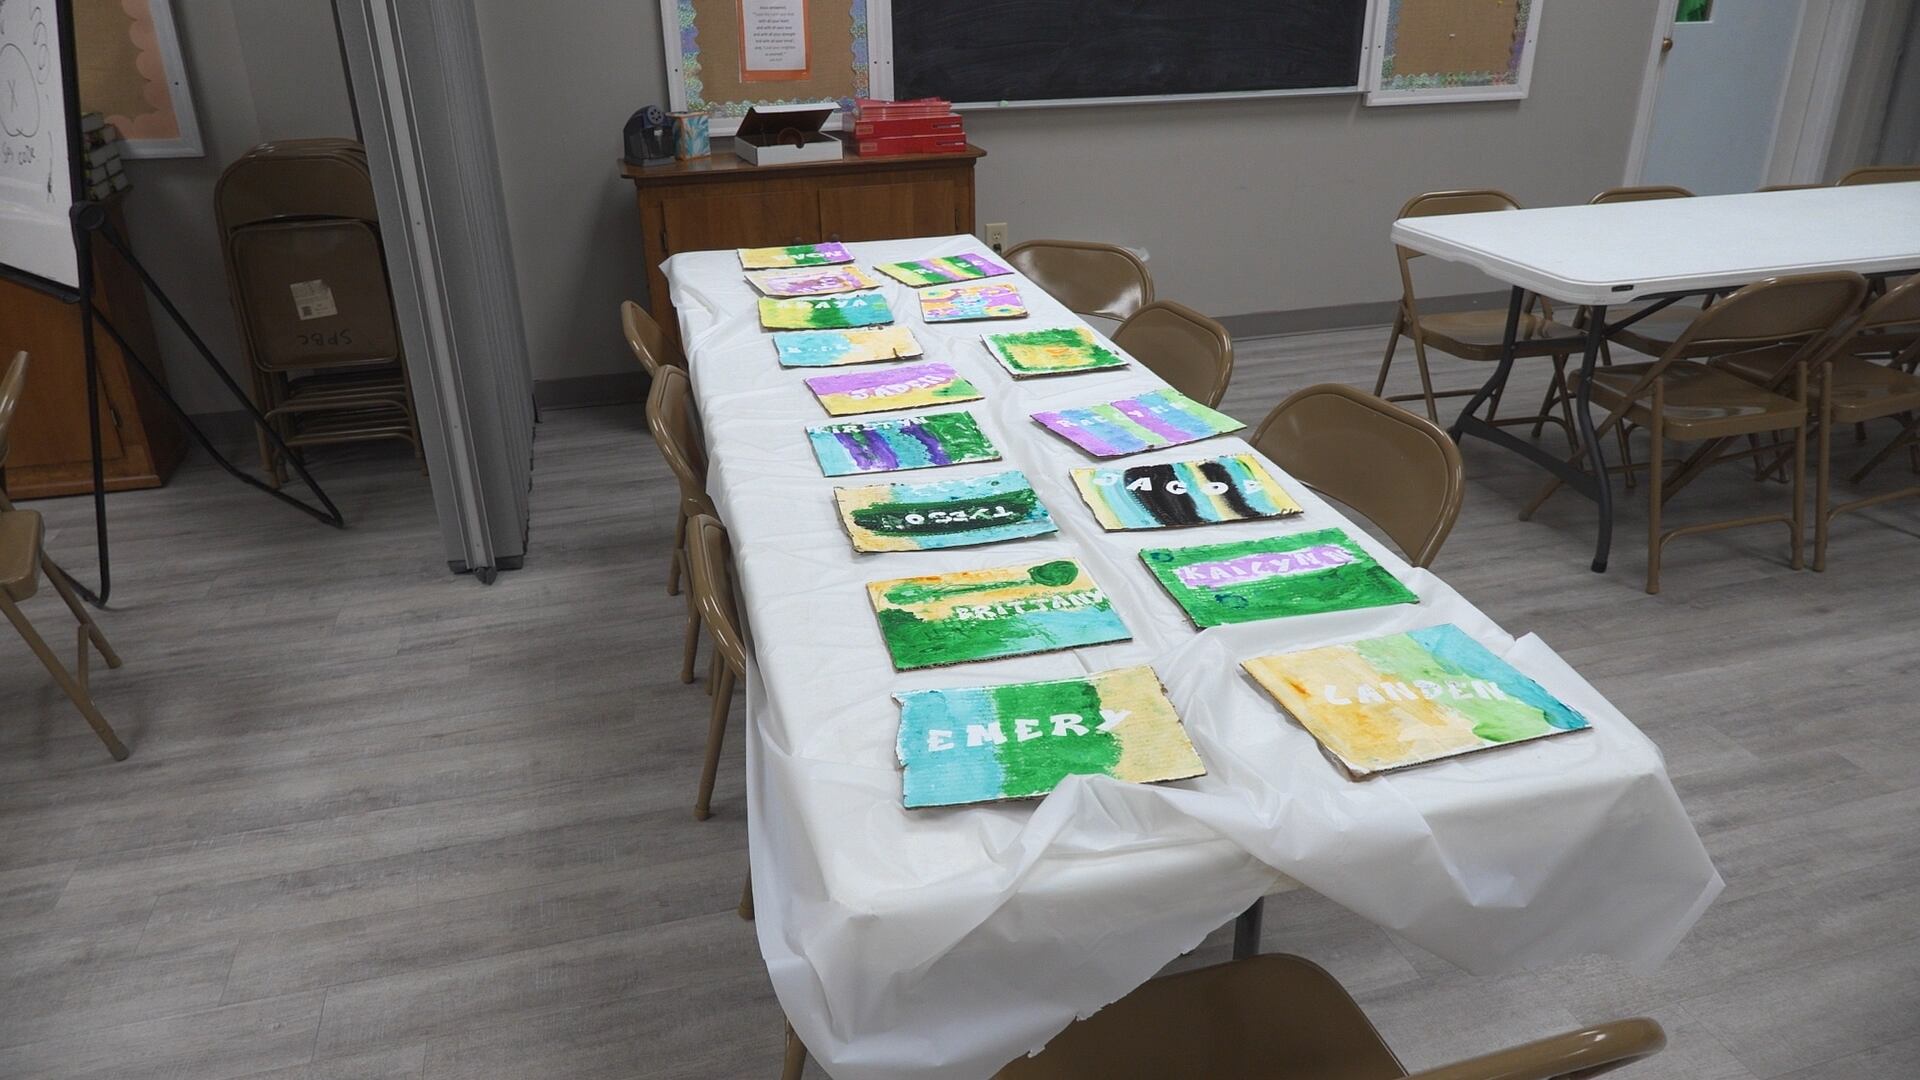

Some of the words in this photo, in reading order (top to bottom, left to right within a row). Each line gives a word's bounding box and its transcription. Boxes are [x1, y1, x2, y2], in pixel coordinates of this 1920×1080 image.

[297, 328, 353, 346] SPBC
[850, 375, 949, 400] JADEN
[955, 588, 1107, 622] BRITTANY
[1323, 679, 1506, 705] LANDEN
[927, 708, 1132, 751] EMERY
